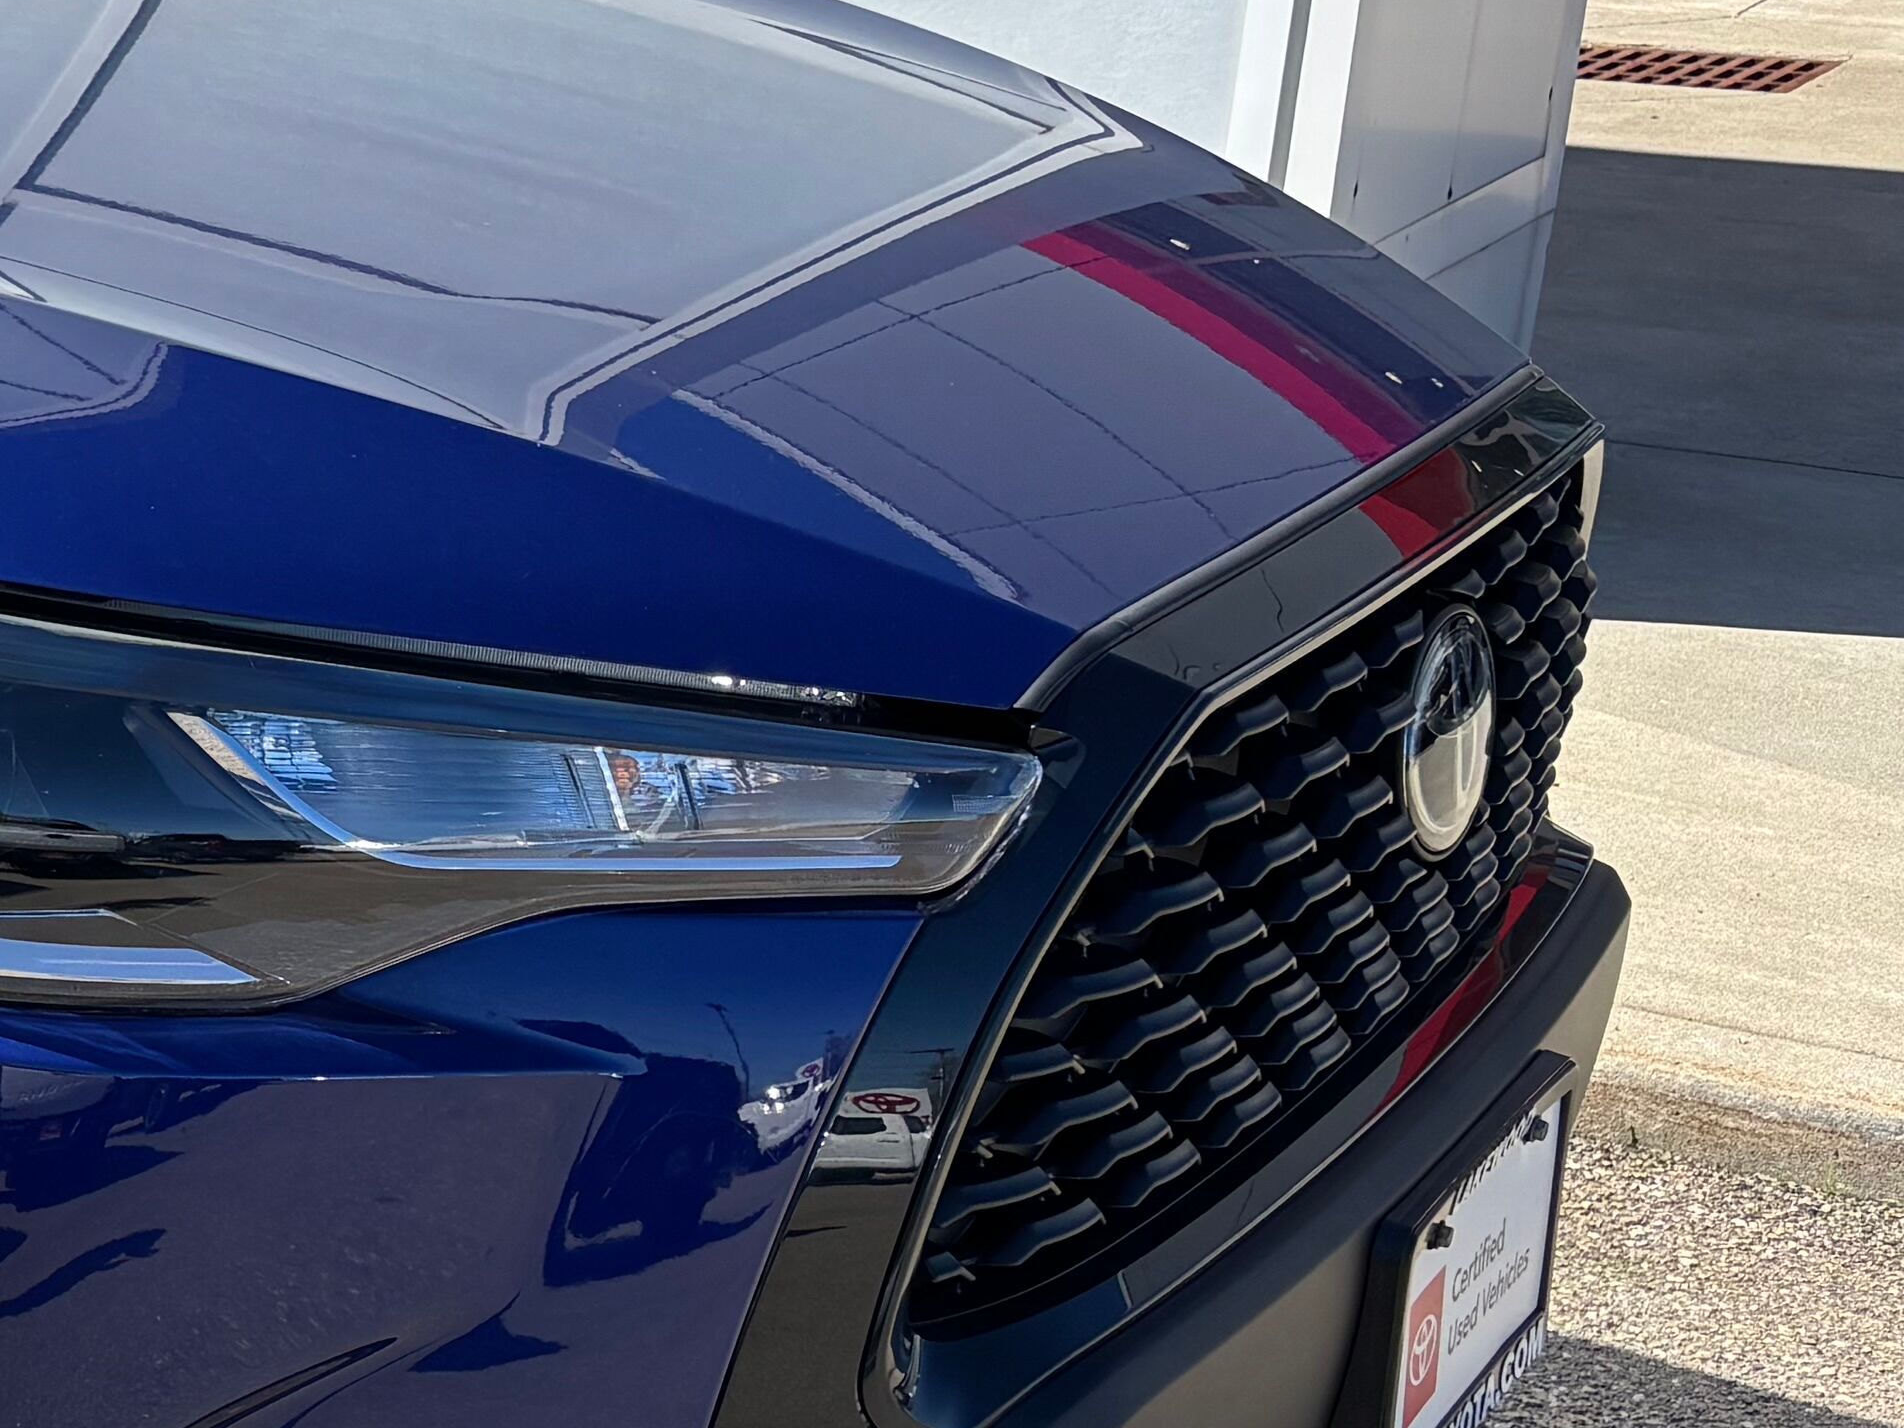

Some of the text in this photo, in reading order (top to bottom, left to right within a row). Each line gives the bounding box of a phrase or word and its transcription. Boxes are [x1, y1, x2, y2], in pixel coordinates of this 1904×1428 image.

[1447, 1301, 1479, 1356] Used
[1481, 1246, 1531, 1317] Vehicles
[1452, 1218, 1508, 1304] Certified
